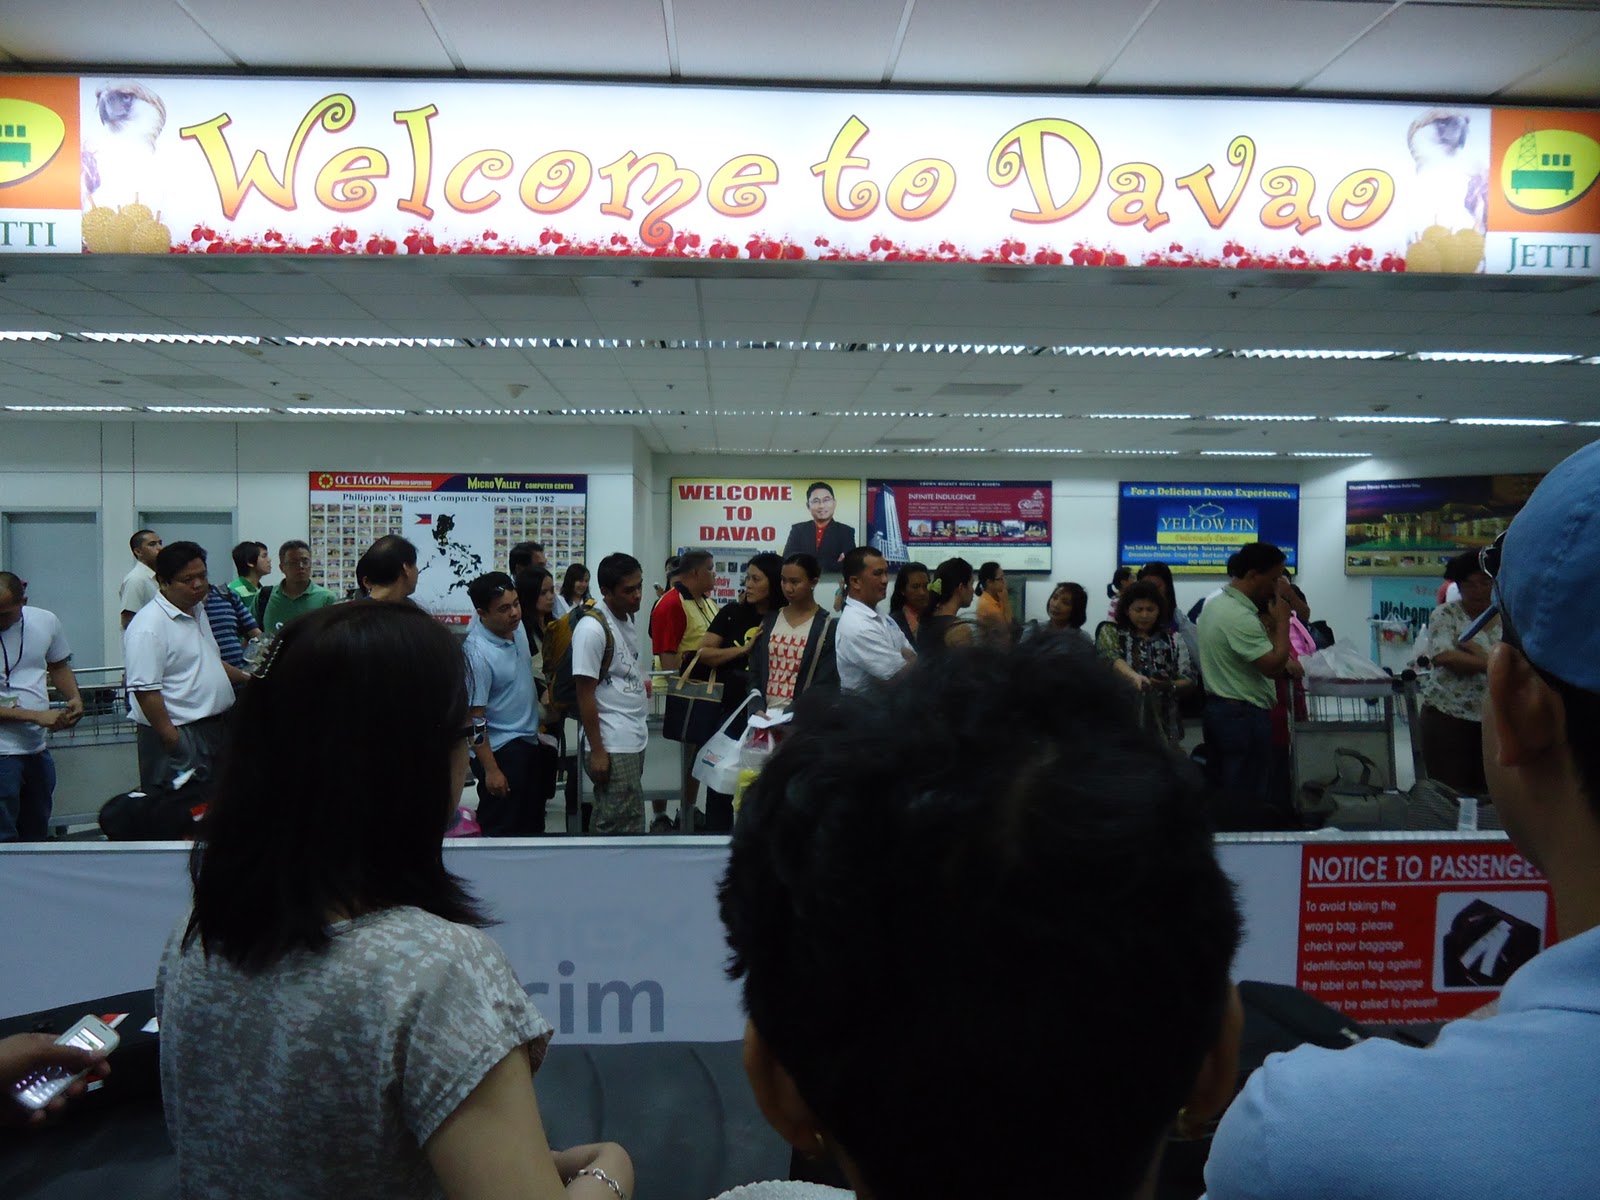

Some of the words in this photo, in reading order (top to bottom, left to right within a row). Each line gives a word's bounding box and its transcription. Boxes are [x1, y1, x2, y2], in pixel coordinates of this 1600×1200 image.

[180, 93, 780, 249] Welcome
[810, 114, 957, 224] to
[987, 117, 1396, 236] Davao
[0, 221, 57, 247] TTI
[1507, 237, 1592, 273] JETTI
[334, 476, 390, 485] OCTAGON
[342, 493, 396, 503] Philippine's
[398, 494, 431, 503] Biggest
[433, 494, 479, 504] Computer
[481, 495, 506, 503] Store
[507, 495, 532, 503] Since
[534, 495, 555, 503] 1982
[679, 485, 792, 501] WELCOME
[908, 493, 934, 501] INFINITE
[1130, 487, 1148, 496] For
[1157, 488, 1202, 497] Delicious
[1204, 488, 1234, 497] Davao
[723, 506, 753, 521] TO
[1161, 518, 1227, 530] YELLOW
[1231, 519, 1255, 531] FIN
[699, 526, 776, 542] DAVAO
[1308, 856, 1388, 881] NOTICE
[1396, 855, 1423, 880] TO
[1430, 853, 1541, 879] PASSENGE
[1306, 901, 1317, 912] To
[1319, 901, 1346, 912] avoid
[1349, 901, 1378, 914] taking
[1381, 901, 1396, 911] the
[1305, 922, 1334, 934] wrong
[1361, 921, 1394, 933] please
[1304, 941, 1333, 952] check
[1336, 942, 1357, 953] your
[1359, 940, 1404, 953] baggage
[1304, 961, 1365, 971] identification
[1368, 960, 1384, 972] tag
[1387, 959, 1422, 972] against
[1303, 980, 1318, 991] the
[1320, 980, 1344, 991] label
[1346, 982, 1359, 990] on
[1361, 979, 1377, 990] the
[1380, 979, 1424, 991] baggage
[1344, 999, 1358, 1010] be
[1360, 998, 1388, 1010] asked
[1391, 998, 1401, 1009] to
[1403, 997, 1438, 1011] present
